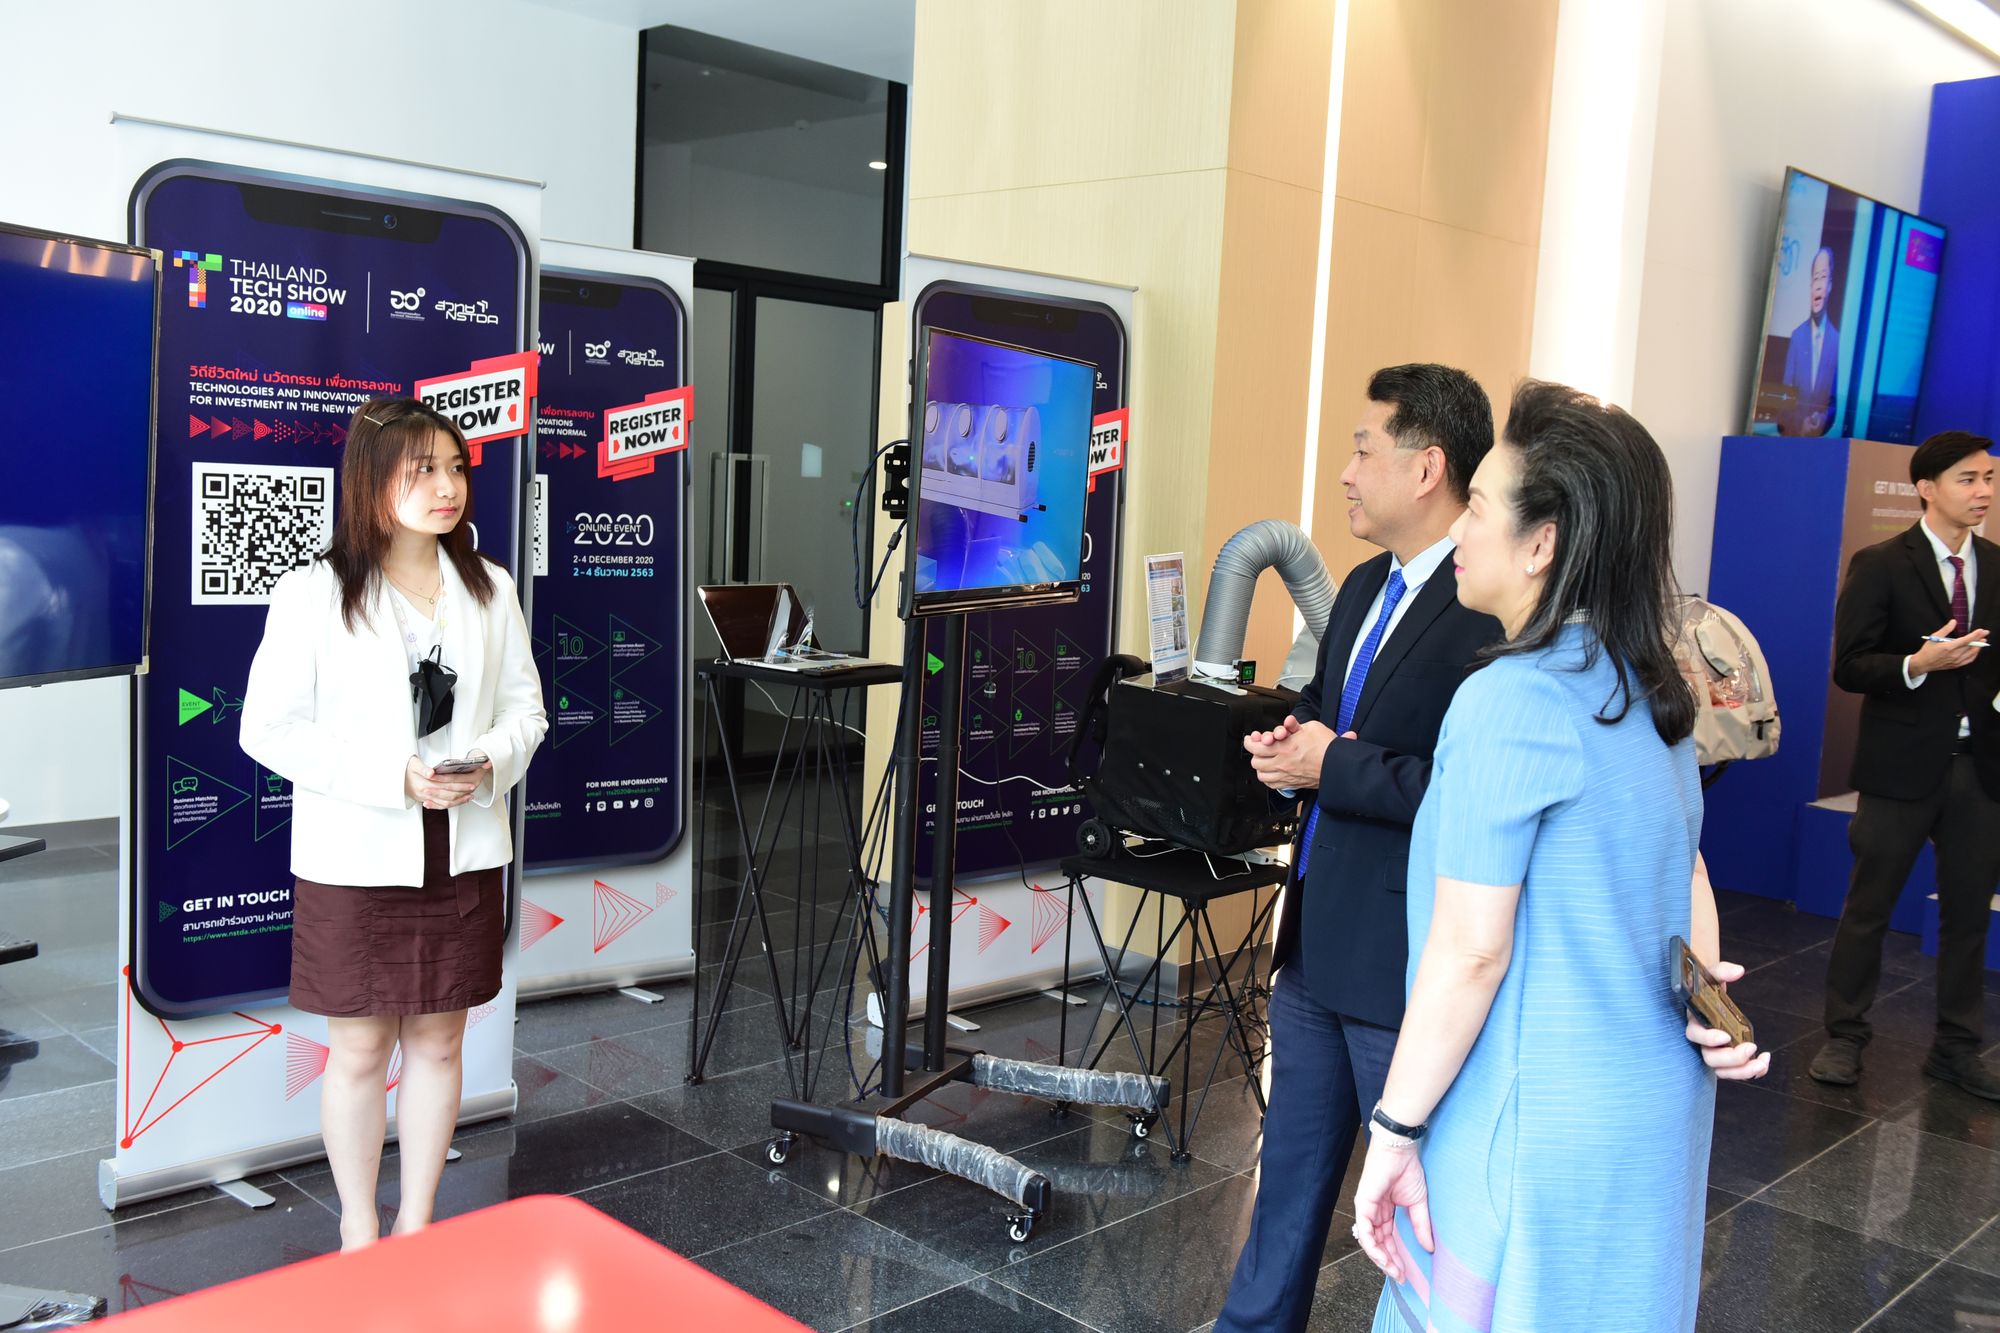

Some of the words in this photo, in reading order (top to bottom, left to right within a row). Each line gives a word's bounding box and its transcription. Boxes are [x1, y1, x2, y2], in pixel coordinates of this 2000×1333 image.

[230, 258, 327, 284] THAILAND
[229, 277, 282, 298] TECH
[287, 284, 346, 305] SHOW
[230, 296, 282, 317] 2020
[289, 306, 325, 318] online
[446, 310, 499, 325] NSTDA
[189, 382, 274, 397] TECHNOLOGIES
[276, 388, 300, 398] AND
[303, 390, 371, 403] INNOVATIONS
[263, 370, 321, 386] นวัตกรรม
[326, 373, 402, 395] เพื่อการลงทุน
[189, 395, 212, 405] FOR
[215, 396, 284, 410] INVESTMENT
[286, 401, 298, 411] IN
[300, 402, 320, 412] THE
[322, 404, 345, 414] NEW
[422, 379, 521, 412] REGISTER
[610, 408, 682, 435] REGISTER
[556, 428, 588, 437] NORMAL
[624, 428, 668, 450] NOW
[574, 512, 654, 546] 2020
[578, 523, 612, 532] ONLINE
[614, 524, 642, 533] EVENT
[588, 556, 634, 564] DECEMBER
[635, 556, 654, 564] 2020
[594, 566, 629, 577] ธันวาคม
[630, 568, 654, 577] 2563
[1080, 584, 1090, 592] 63
[559, 636, 584, 656] 10
[600, 780, 620, 788] MORE
[620, 777, 668, 787] INFORMATIONS
[957, 799, 984, 811] TOUCH
[182, 897, 213, 912] GET
[217, 895, 234, 908] IN
[238, 888, 290, 906] TOUCH
[182, 914, 264, 932] สามารถเข้าร่วมงาน
[183, 924, 294, 944] https://www.nstda.or.th/thailan
